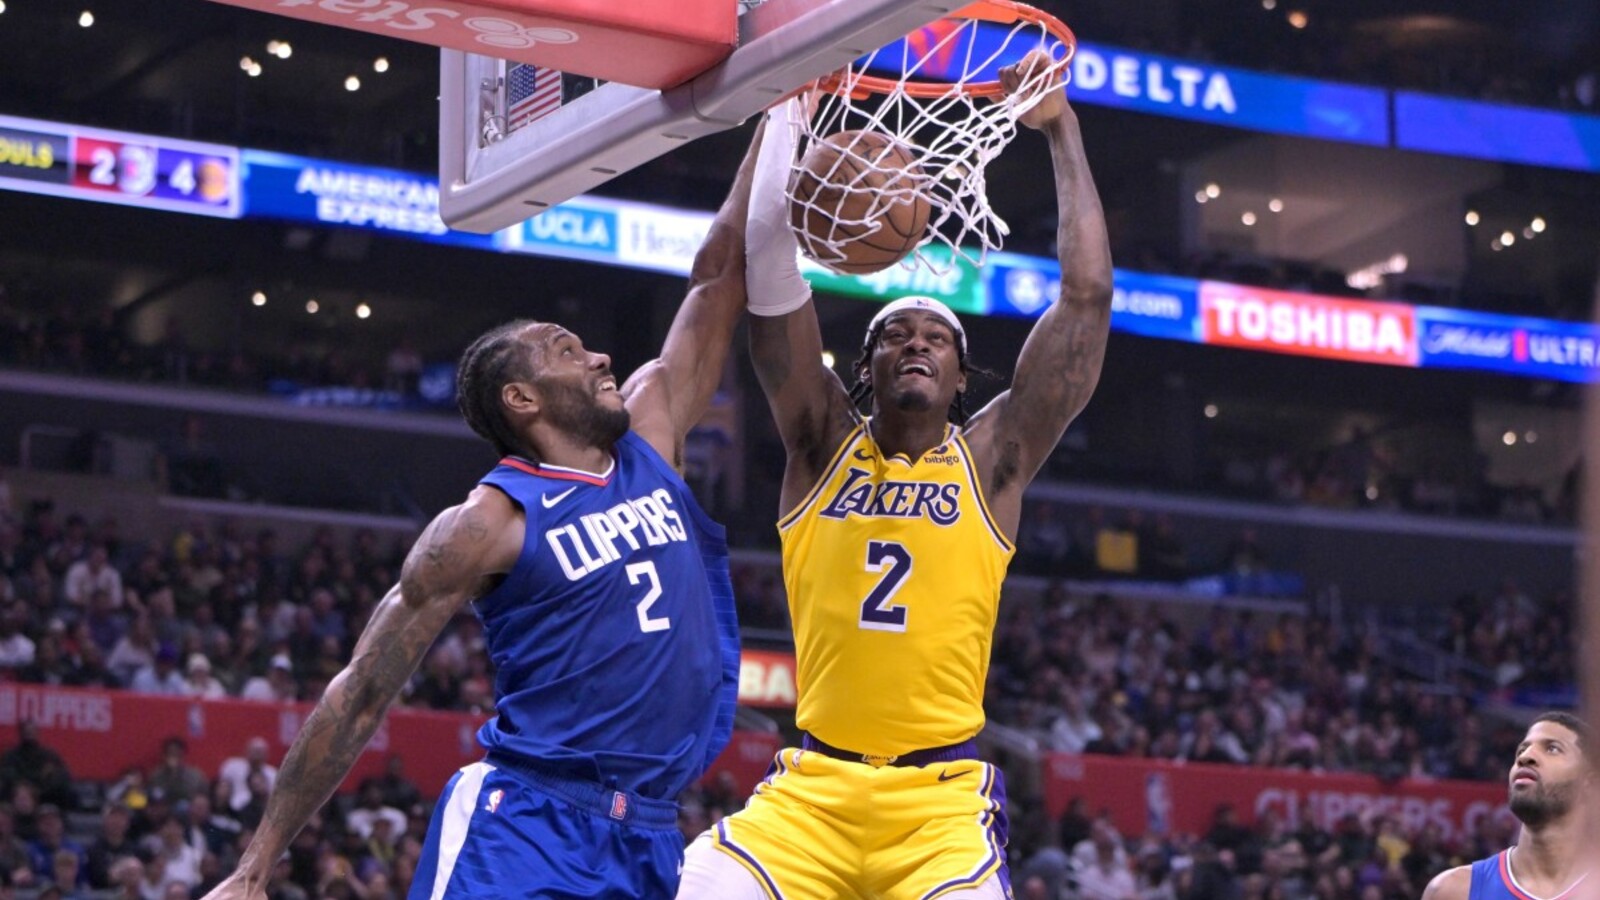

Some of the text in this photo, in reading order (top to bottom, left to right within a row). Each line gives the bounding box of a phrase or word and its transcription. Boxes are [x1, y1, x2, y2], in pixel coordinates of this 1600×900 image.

[1072, 49, 1237, 114] DELTA
[89, 148, 115, 185] 2
[169, 159, 196, 195] 4
[296, 167, 440, 209] AMERICAN
[317, 198, 448, 235] EXPRESS
[530, 206, 610, 248] UCLA
[1213, 297, 1406, 356] TOSHIBA
[819, 467, 961, 528] LAKERS
[545, 488, 688, 582] CLIPPERS
[625, 560, 670, 633] 2
[858, 539, 912, 632] 2
